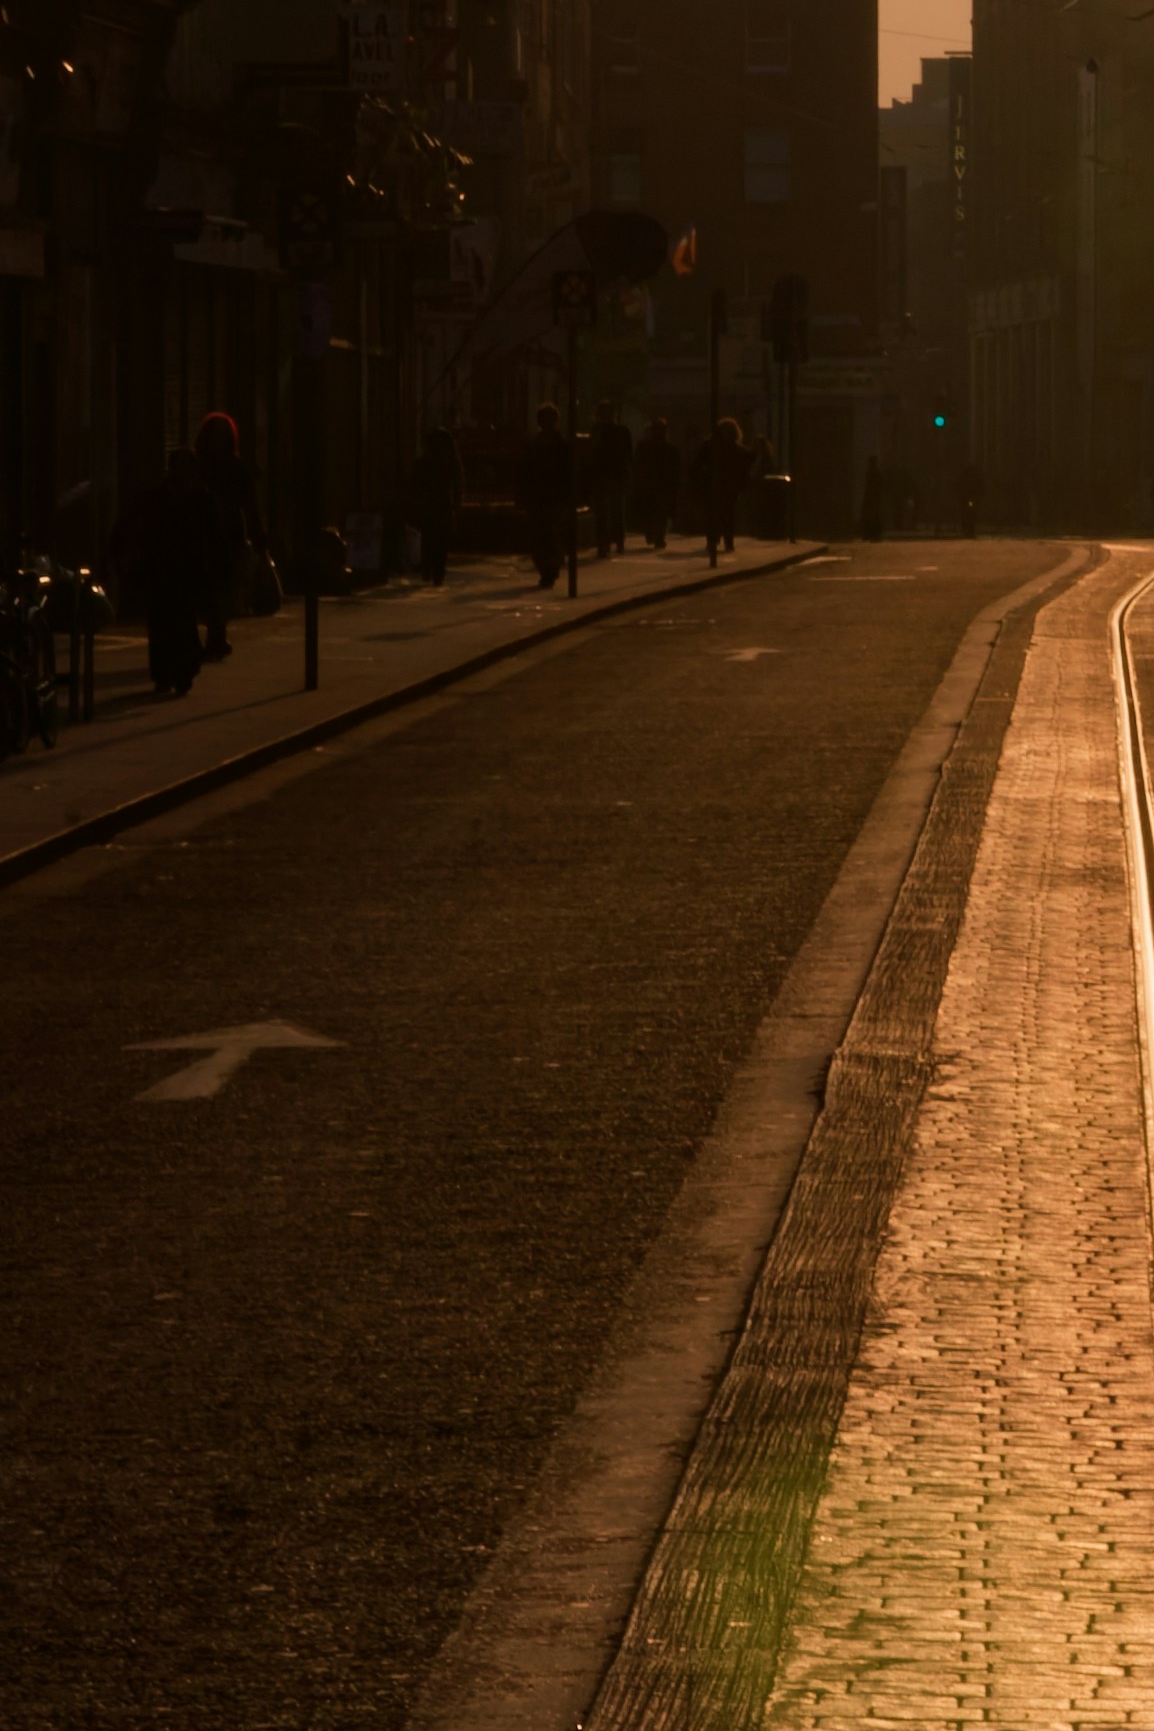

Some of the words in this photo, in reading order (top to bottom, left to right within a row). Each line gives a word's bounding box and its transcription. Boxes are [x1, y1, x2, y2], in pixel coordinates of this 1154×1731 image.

[352, 40, 395, 62] AVEL
[351, 68, 391, 85] loor
[953, 93, 967, 222] JERVIS
